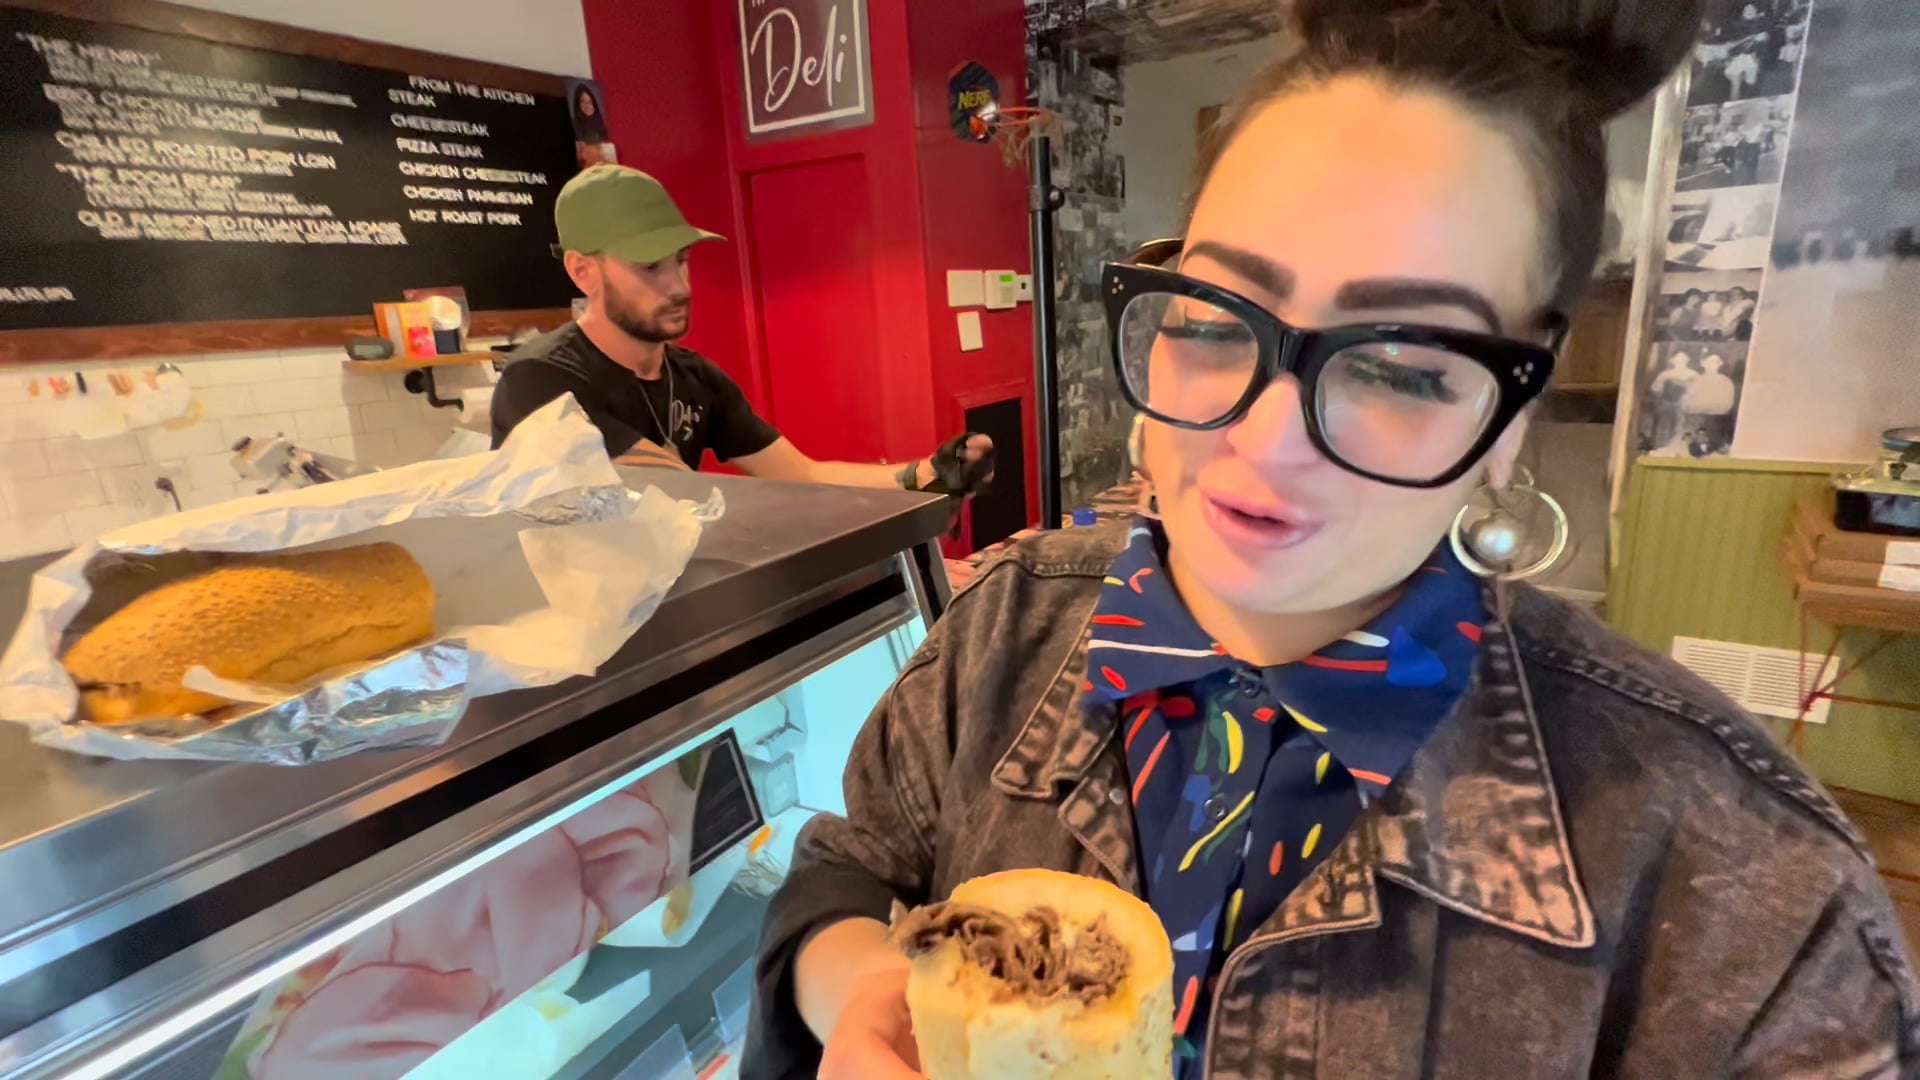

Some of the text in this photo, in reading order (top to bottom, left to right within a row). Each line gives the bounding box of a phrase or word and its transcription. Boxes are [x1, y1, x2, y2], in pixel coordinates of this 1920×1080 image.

[750, 4, 847, 112] Deli
[387, 88, 437, 108] STEAK
[409, 75, 536, 106] FROM THE KITCHEN
[390, 113, 490, 137] CHEESESTEAK
[153, 139, 246, 162] ROASTED
[298, 152, 337, 170] LOIN
[395, 137, 485, 159] PIZZA STEAK
[399, 161, 548, 186] CHICKEN CHEESESTEAK
[403, 185, 534, 206] CHICKEN PARMESAN
[237, 215, 304, 233] ITALIAN
[303, 217, 349, 234] TUNA
[409, 208, 522, 226] HOT ROAST PORK
